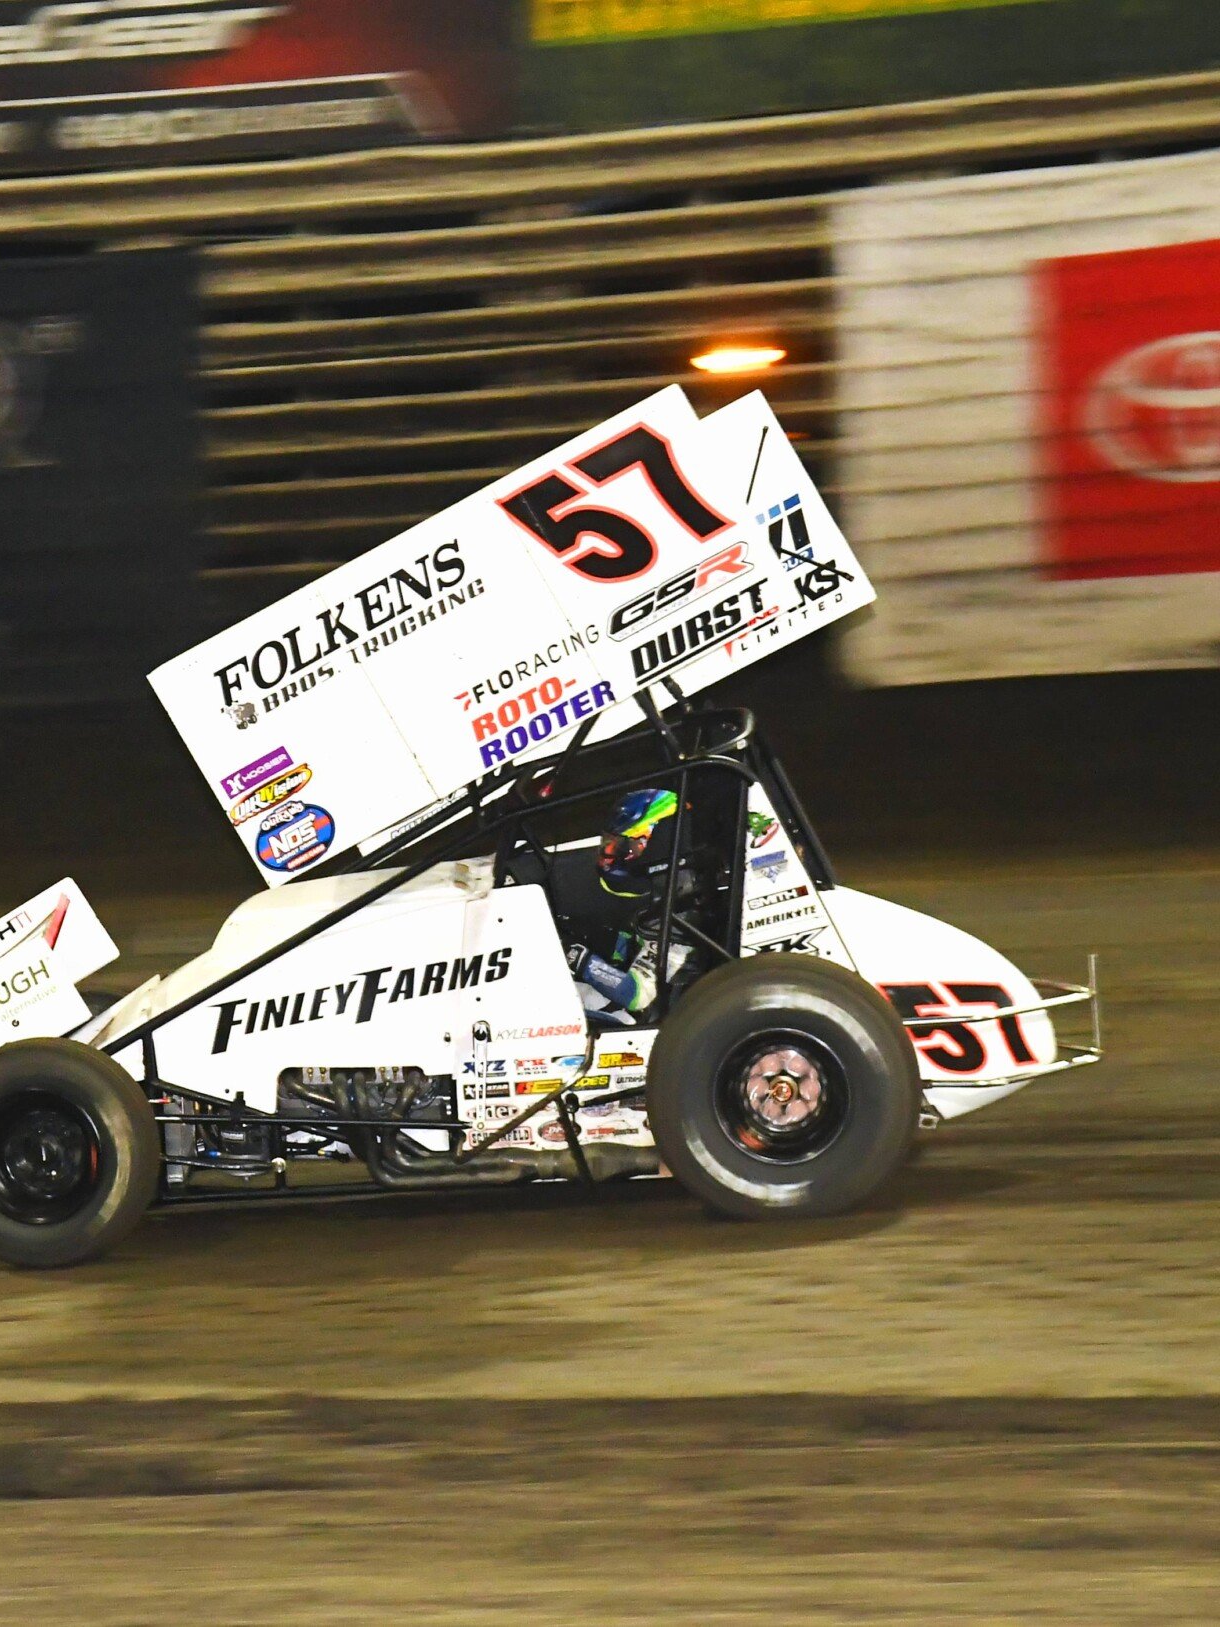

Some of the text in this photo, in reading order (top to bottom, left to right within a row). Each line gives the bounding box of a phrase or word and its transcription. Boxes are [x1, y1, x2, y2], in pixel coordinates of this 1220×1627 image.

[495, 421, 737, 584] 57
[213, 539, 466, 707] FOLKENS
[610, 545, 748, 635] GSR
[630, 577, 769, 679] DURST
[740, 593, 843, 652] LIMITED
[262, 577, 486, 713] BROS. TRUCKING
[472, 676, 577, 742] ROTO-
[479, 680, 617, 769] ROOTER
[242, 753, 288, 783] HOOSIER
[268, 813, 318, 859] NOS
[1, 985, 58, 1024] alternative
[207, 980, 359, 1055] FINLEY
[353, 947, 513, 1024] FARMS
[876, 981, 1039, 1075] 57
